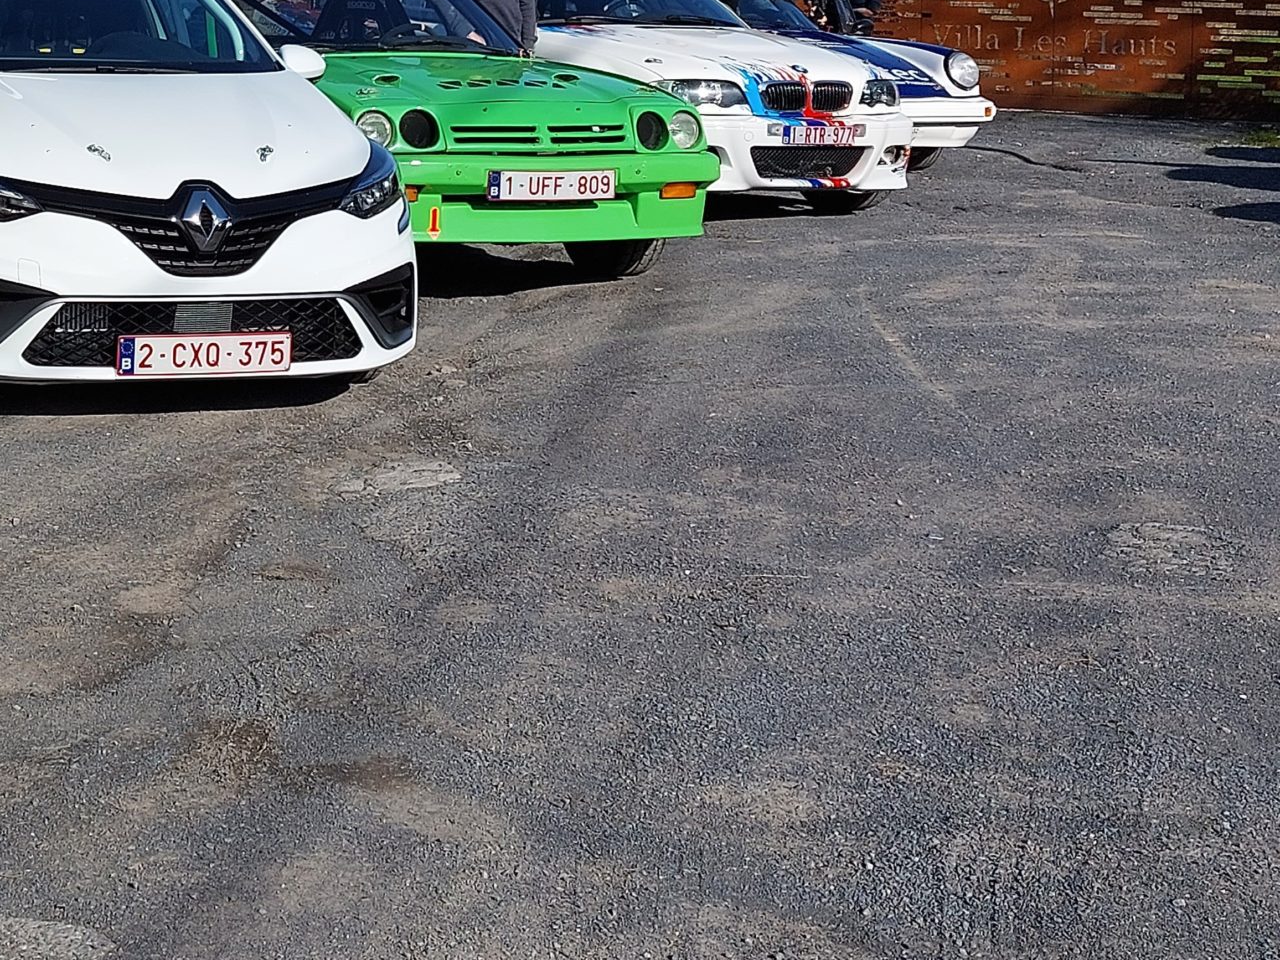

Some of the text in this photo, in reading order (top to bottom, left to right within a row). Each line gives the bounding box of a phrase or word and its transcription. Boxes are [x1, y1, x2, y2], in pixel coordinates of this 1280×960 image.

[931, 23, 1179, 57] Villa Les Hauts
[490, 186, 499, 196] B
[121, 358, 132, 370] B
